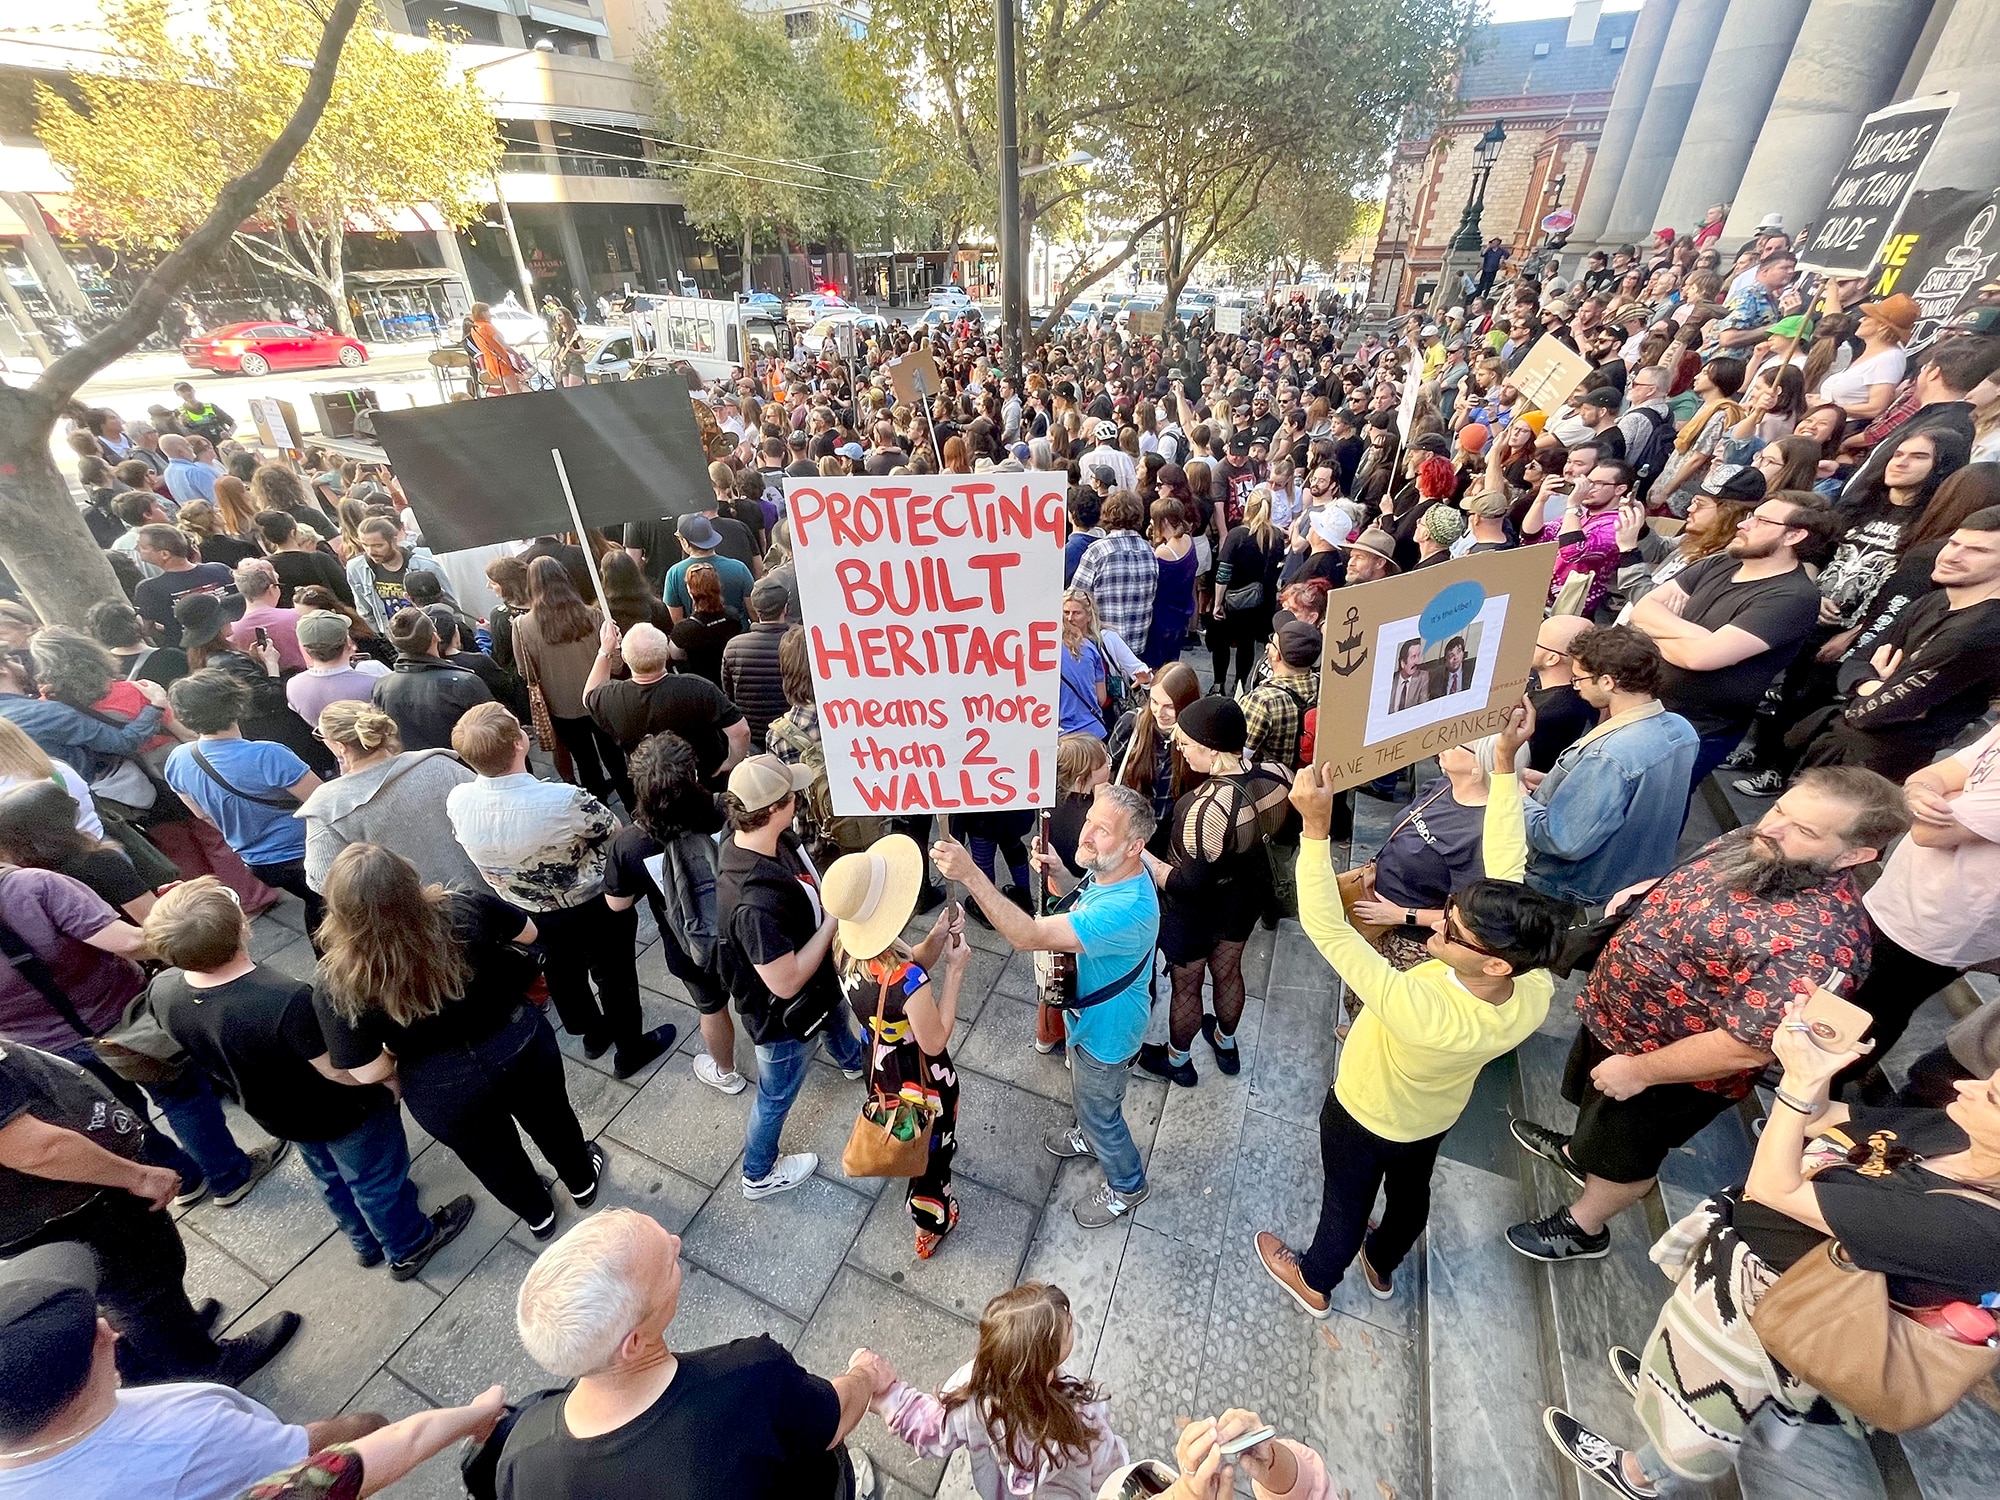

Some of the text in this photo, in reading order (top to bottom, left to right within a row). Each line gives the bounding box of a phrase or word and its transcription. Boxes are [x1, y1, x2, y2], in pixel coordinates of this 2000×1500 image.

[1855, 171, 1914, 207] THAN
[1876, 233, 1920, 266] HE
[1922, 271, 1974, 292] SAVE THE
[789, 483, 1065, 550] PROTECTING
[835, 552, 1021, 616] BUILT
[811, 621, 1059, 687] HERITAGE
[822, 693, 1053, 729] means more
[850, 728, 998, 772] than 2
[1332, 756, 1364, 781] AVE
[1374, 740, 1407, 766] THE
